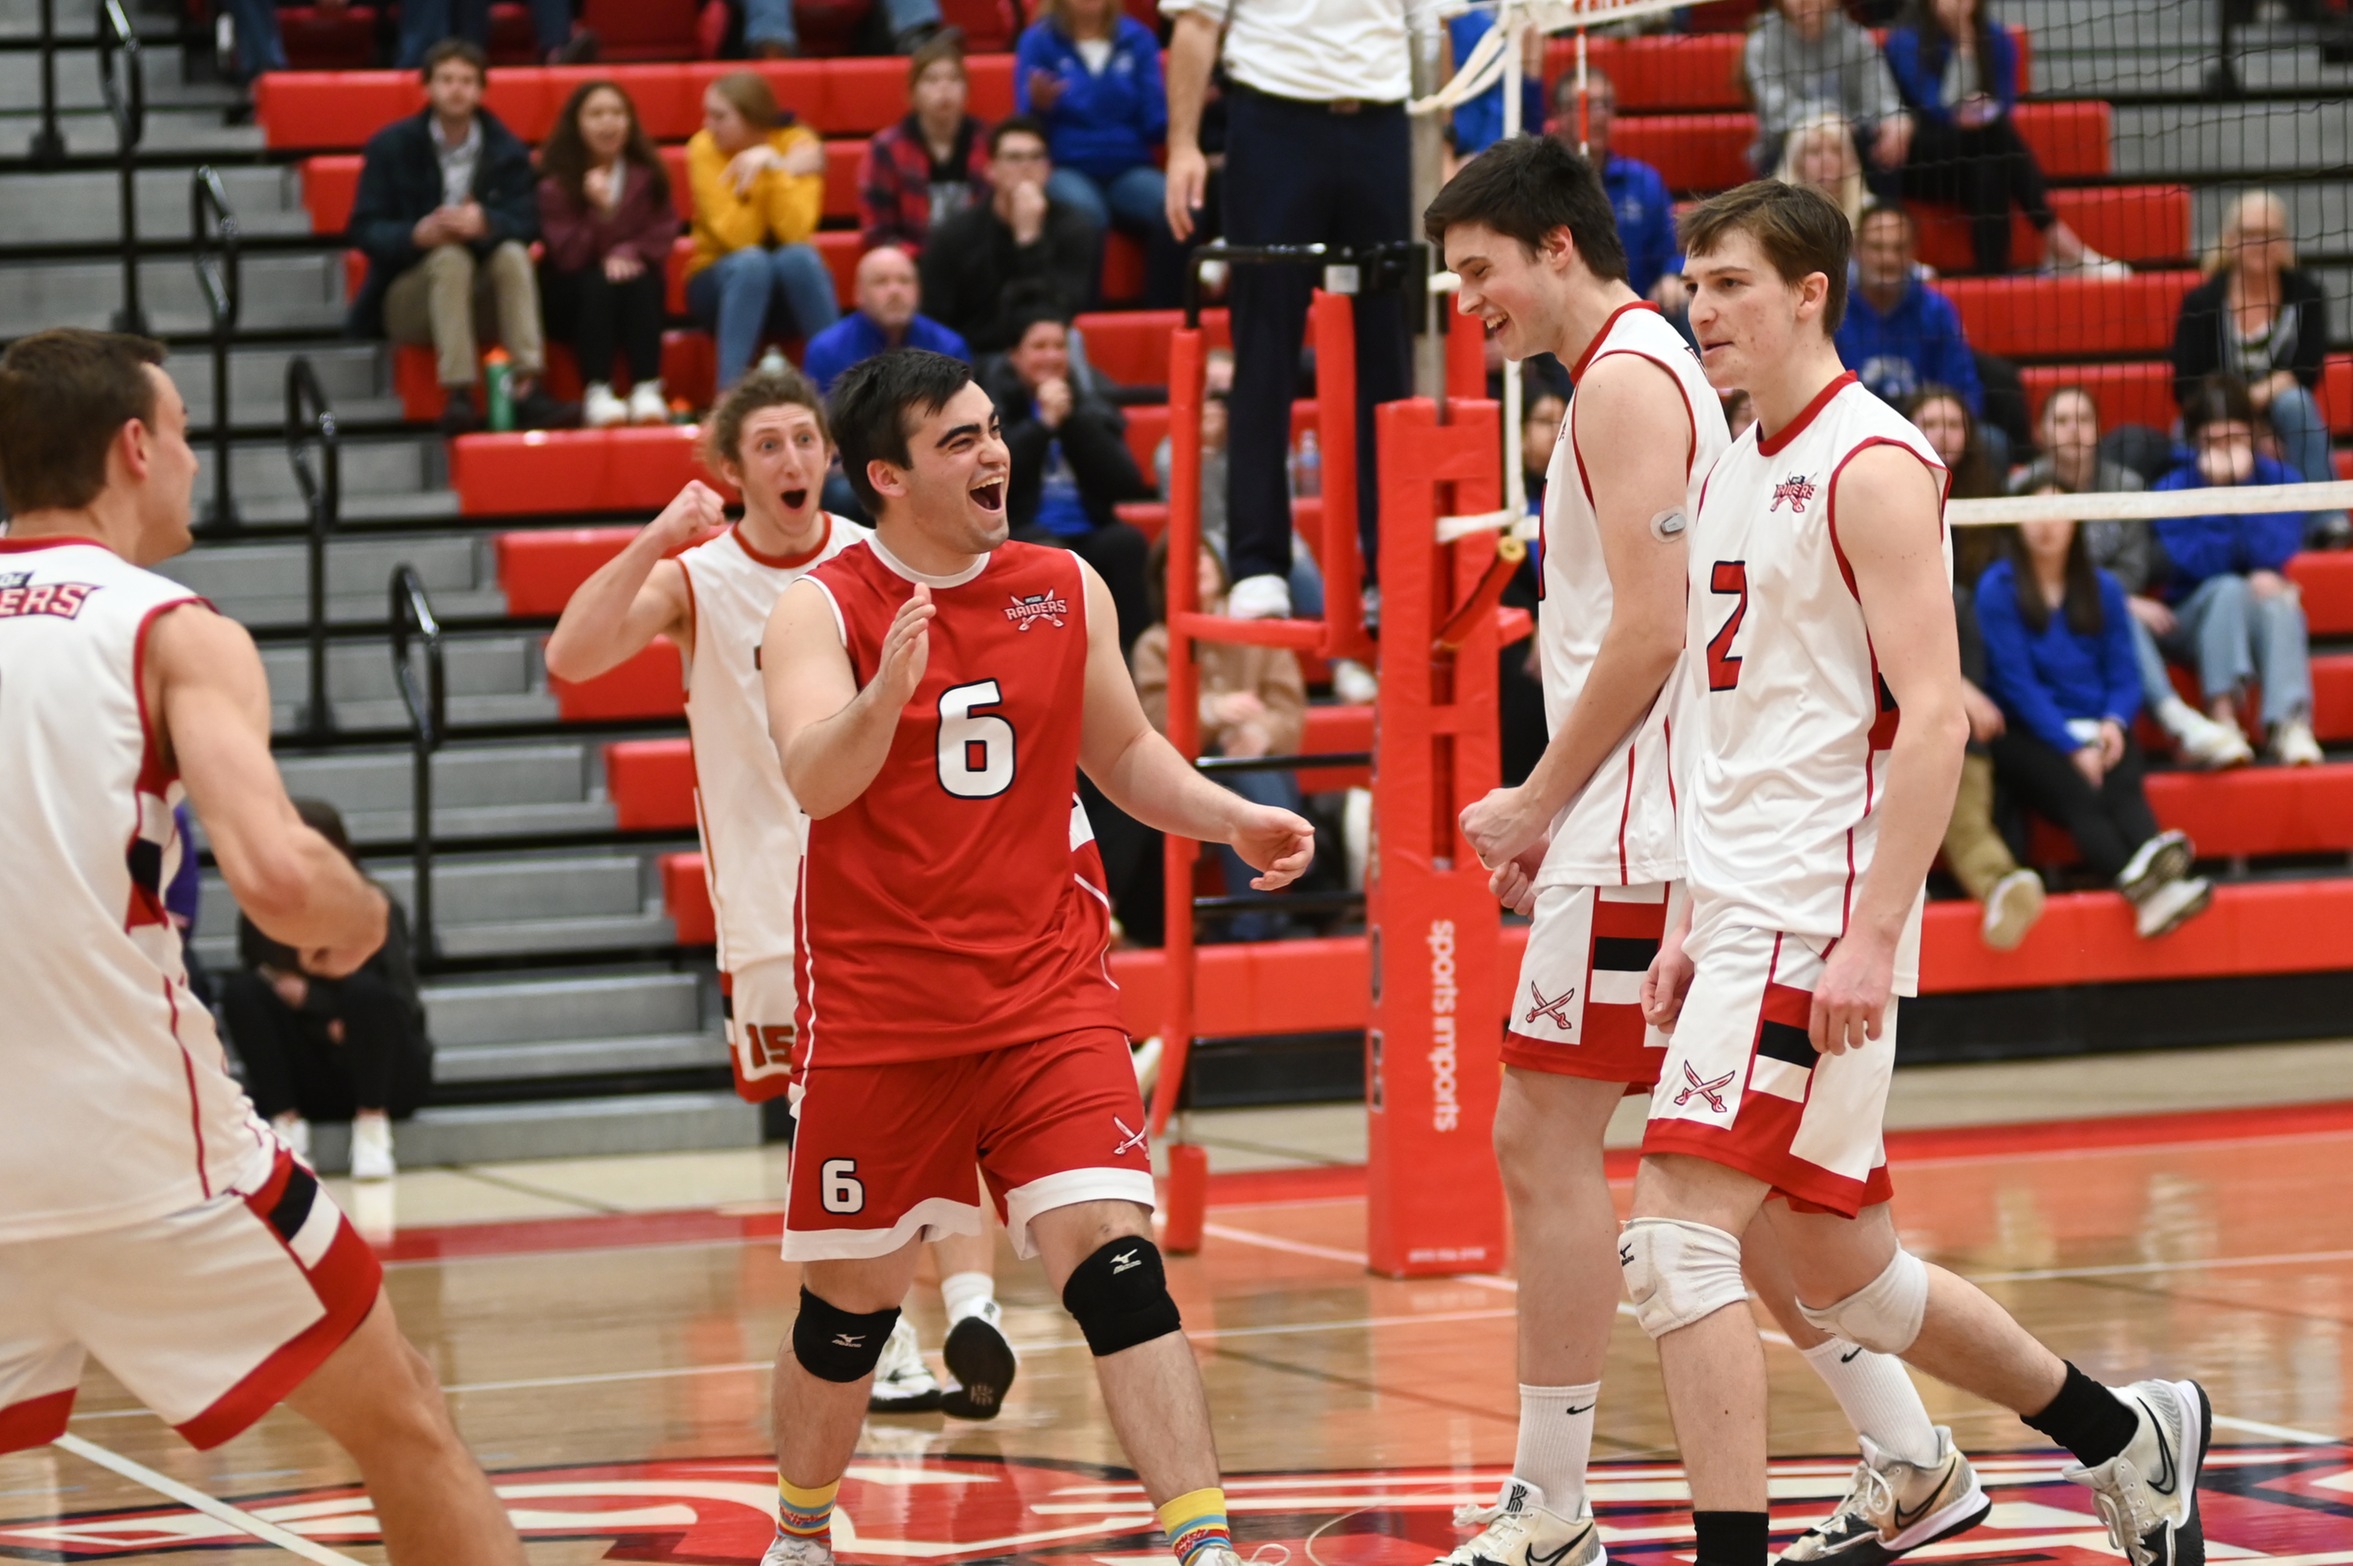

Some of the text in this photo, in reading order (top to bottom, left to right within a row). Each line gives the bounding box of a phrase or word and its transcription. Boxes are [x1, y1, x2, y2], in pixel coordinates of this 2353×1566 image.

[1003, 599, 1068, 620] RAIDERS
[1706, 560, 1748, 692] 2
[936, 677, 1017, 800] 6
[745, 1023, 795, 1069] 15
[1426, 919, 1461, 1132] sports imports
[820, 1157, 866, 1214] 6
